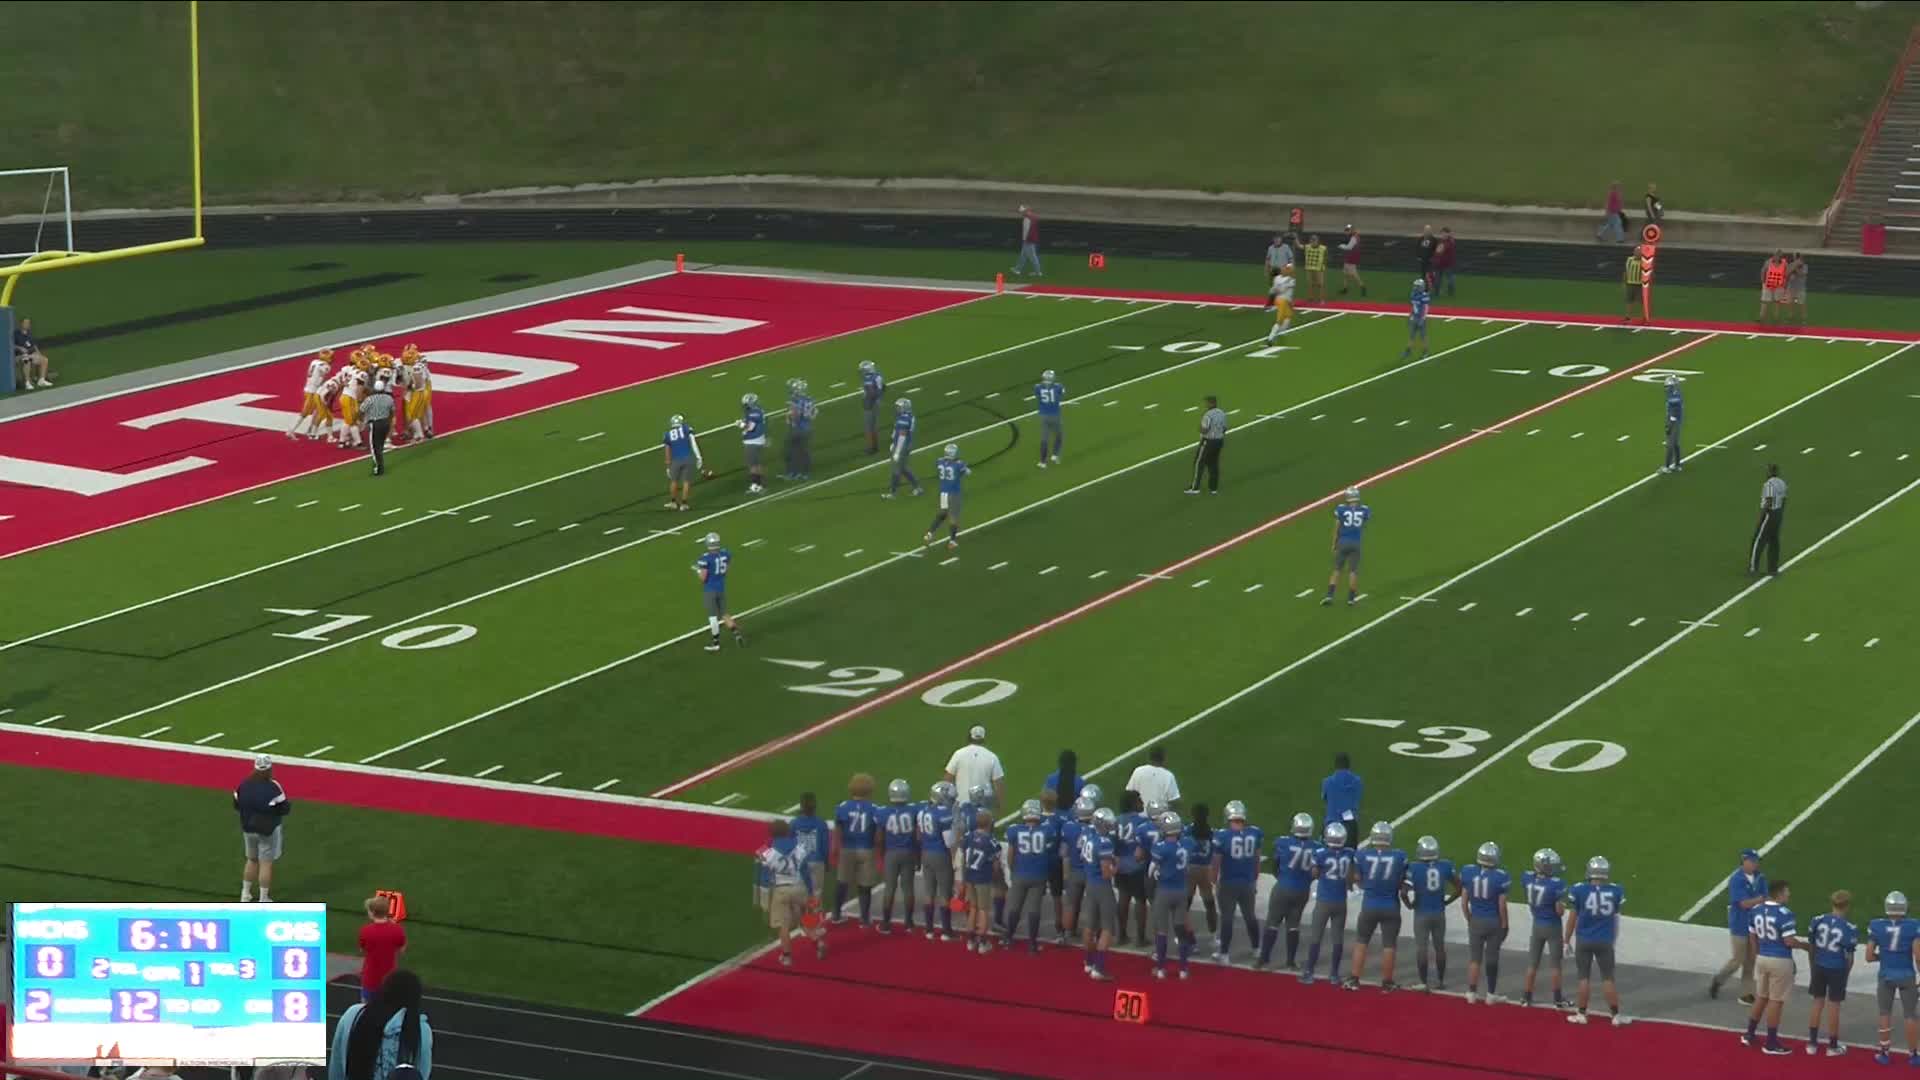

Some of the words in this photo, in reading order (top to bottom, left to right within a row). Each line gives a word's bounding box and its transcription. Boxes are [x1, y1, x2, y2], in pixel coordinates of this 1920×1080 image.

[1040, 388, 1055, 403] 51
[0, 304, 769, 520] LTON
[669, 426, 684, 441] 81
[937, 465, 954, 481] 33
[1343, 510, 1363, 527] 35
[715, 556, 728, 575] 15
[273, 614, 477, 650] 10
[787, 666, 1019, 708] 20
[1388, 725, 1628, 773] 30
[848, 812, 867, 832] 71
[886, 814, 912, 834] 40
[1017, 832, 1044, 854] 50
[1230, 836, 1255, 858] 60
[1288, 847, 1313, 871] 70
[1325, 857, 1350, 880] 20
[1366, 856, 1394, 880] 77
[1426, 869, 1440, 891] 8
[1473, 877, 1488, 899] 11
[1527, 883, 1545, 906] 17
[1585, 892, 1614, 916] 45
[130, 920, 217, 950] 6:14
[1754, 915, 1778, 940] 85
[1816, 923, 1842, 952] 32
[1886, 926, 1901, 951] 7
[36, 946, 64, 978] 0
[92, 958, 110, 978] 2
[239, 959, 256, 979] 3
[283, 948, 310, 978] 0
[188, 962, 201, 987] 1
[25, 990, 51, 1021] 2
[117, 990, 160, 1021] 12
[284, 991, 310, 1021] 8
[1117, 993, 1142, 1019] 30
